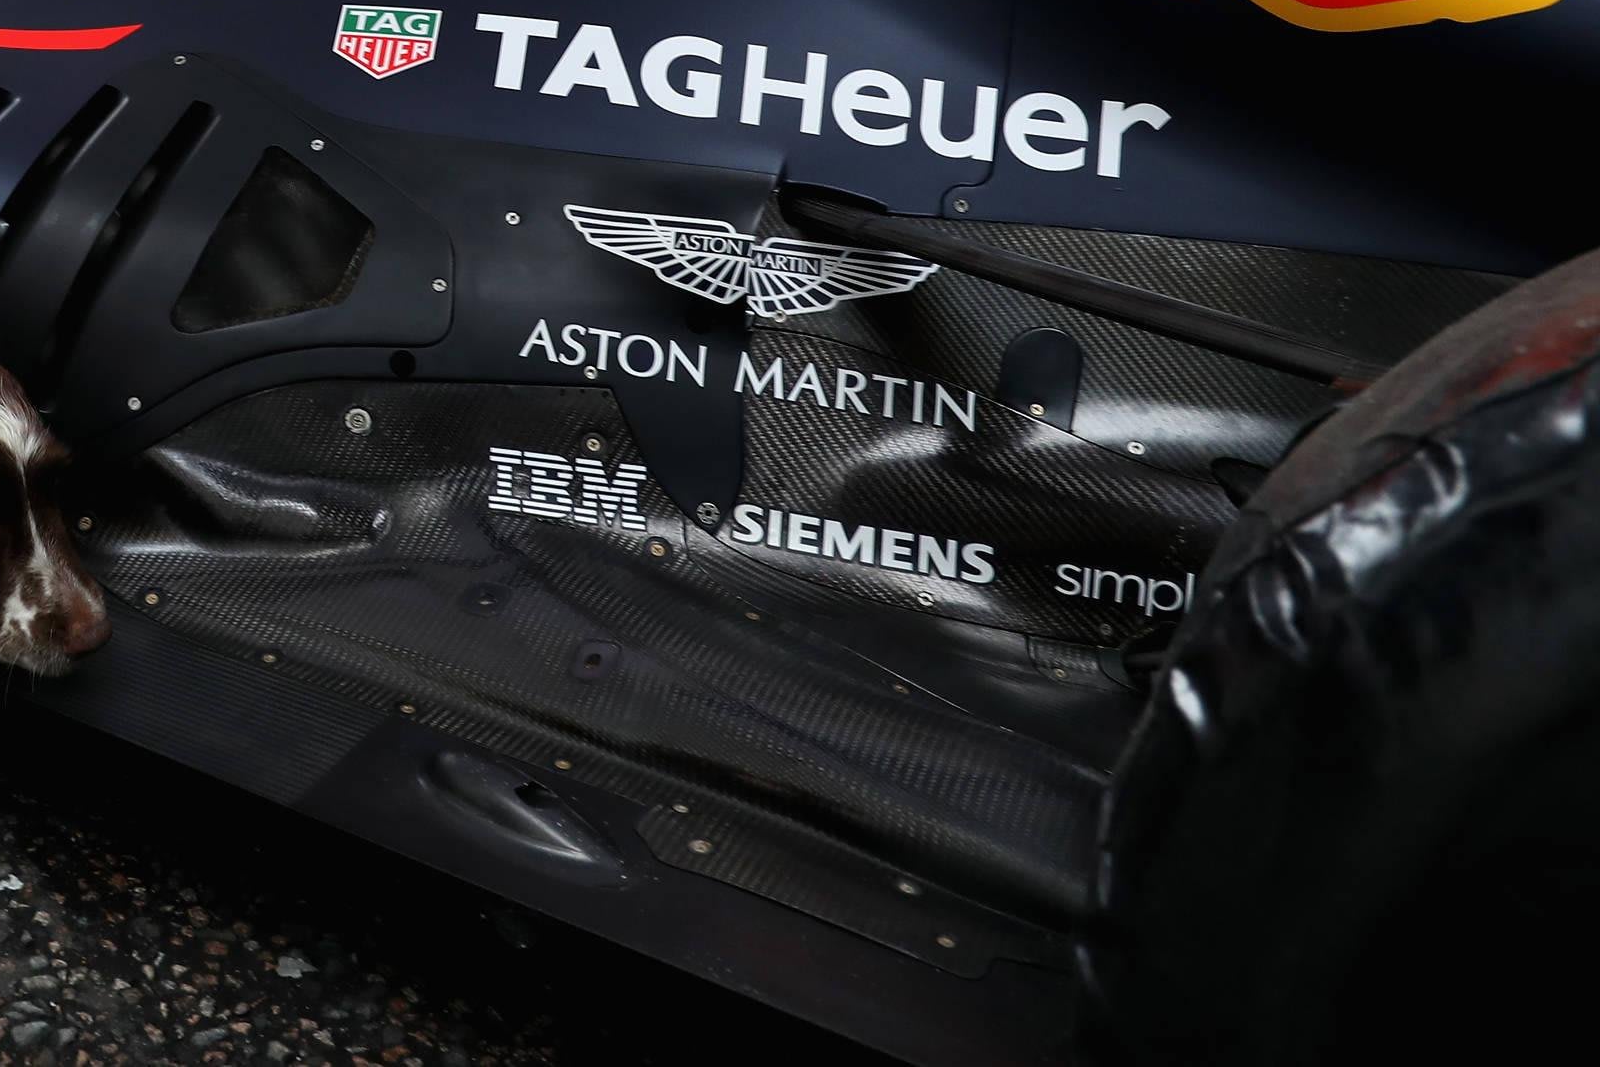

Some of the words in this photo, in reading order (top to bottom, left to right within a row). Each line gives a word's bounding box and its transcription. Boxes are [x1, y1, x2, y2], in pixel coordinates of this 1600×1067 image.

[349, 10, 431, 35] TAG
[340, 36, 430, 73] HEUER
[674, 233, 745, 257] ASTON
[746, 244, 820, 275] MARTIN
[518, 318, 708, 388] ASTON
[733, 351, 977, 432] MARTIN
[488, 446, 647, 532] IBM
[731, 503, 997, 585] SIEMENS
[1054, 563, 1196, 617] simpl
